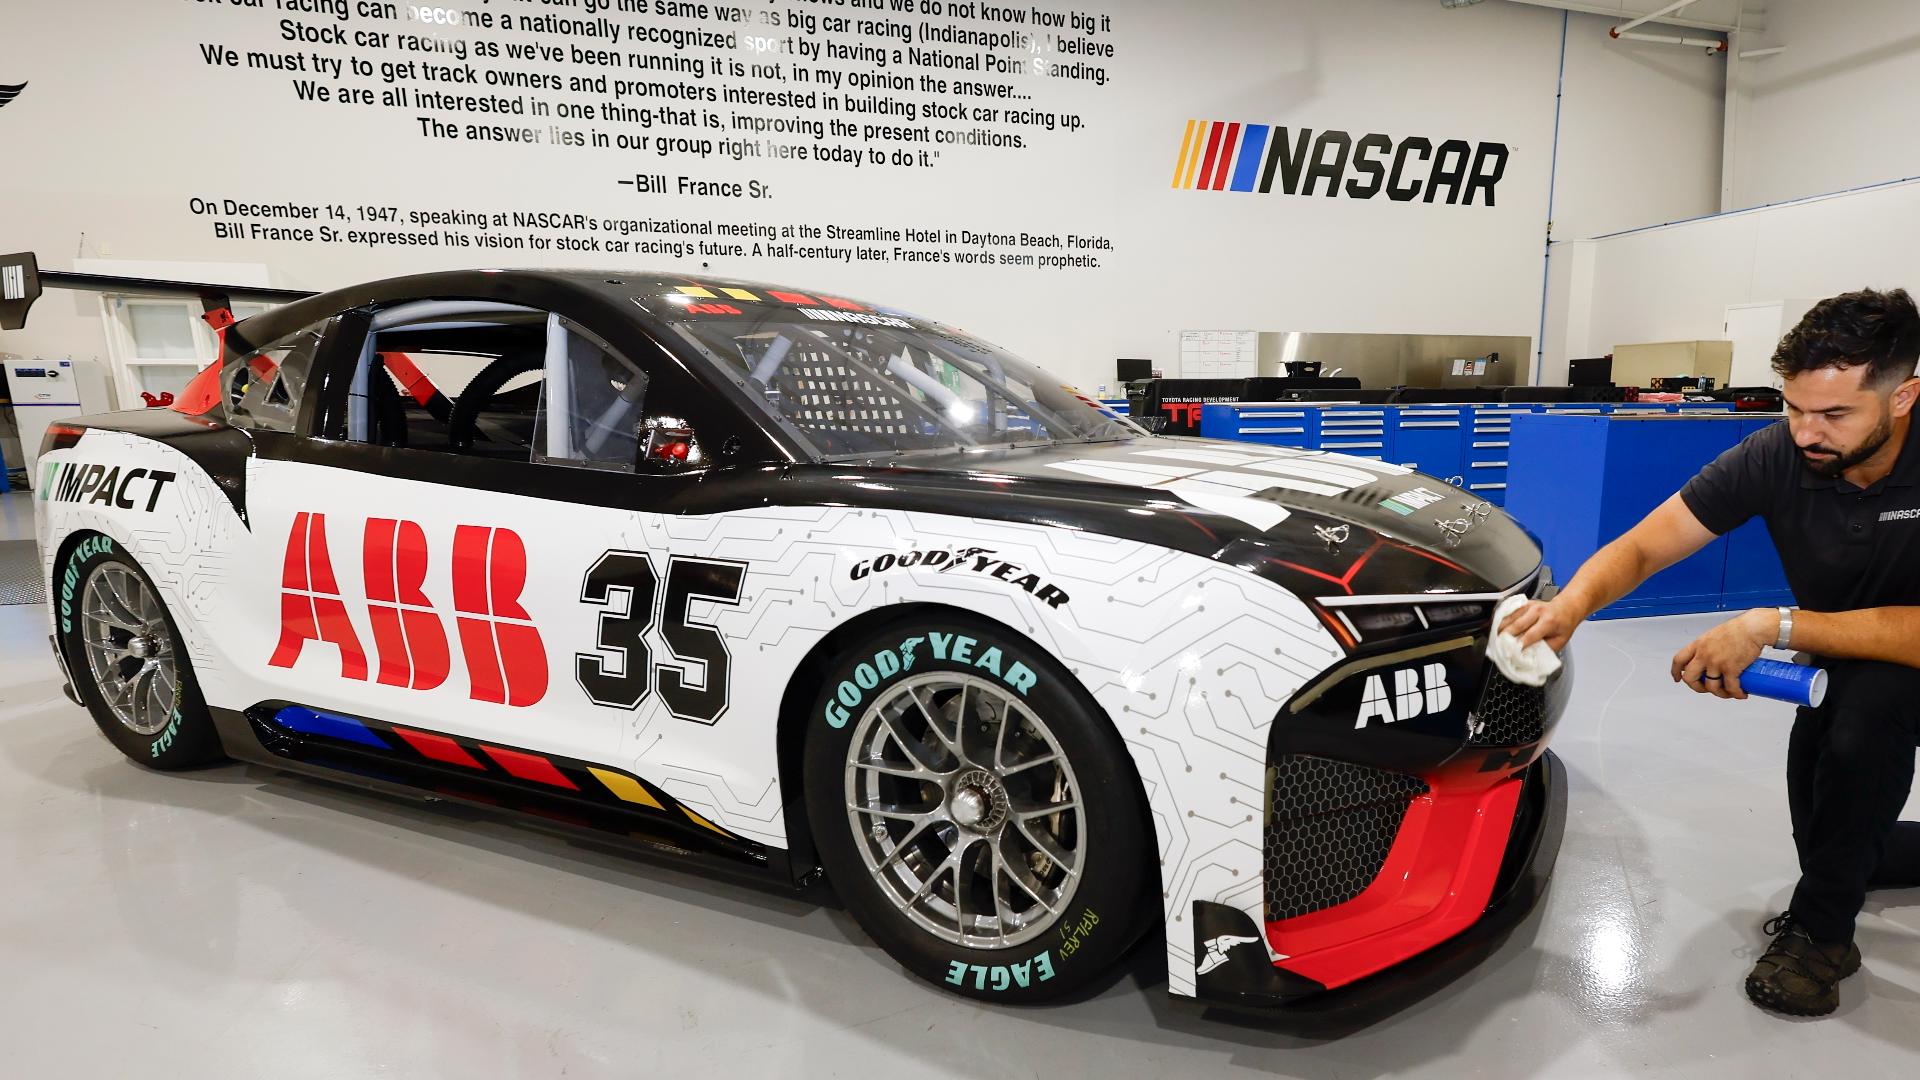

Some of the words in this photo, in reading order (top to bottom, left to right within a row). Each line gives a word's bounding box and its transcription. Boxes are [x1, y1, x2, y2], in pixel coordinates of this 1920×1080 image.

[275, 0, 350, 22] racing
[356, 0, 398, 21] can
[406, 4, 494, 29] become
[499, 13, 513, 31] a
[519, 13, 621, 45] nationally
[627, 25, 737, 50] recognized
[743, 34, 795, 55] sport
[798, 35, 821, 62] by
[826, 38, 887, 68] having
[892, 49, 903, 65] a
[908, 46, 980, 71] National
[583, 0, 611, 15] go
[616, 0, 649, 15] the
[654, 0, 709, 20] same
[713, 5, 753, 28] way
[759, 10, 781, 27] as
[786, 8, 817, 36] big
[822, 16, 852, 33] car
[856, 17, 913, 44] racing
[1056, 34, 1115, 58] believe
[889, 0, 915, 14] we
[919, 0, 943, 16] do
[947, 1, 976, 20] not
[980, 1, 1027, 24] know
[1031, 6, 1066, 28] how
[1070, 10, 1096, 36] big
[1100, 13, 1111, 33] it
[279, 18, 349, 46] Stock
[354, 30, 390, 49] car
[397, 34, 468, 61] racing
[474, 40, 500, 58] as
[504, 41, 565, 63] we've
[570, 43, 622, 67] been
[627, 52, 705, 80] running
[710, 55, 724, 76] it
[728, 57, 746, 78] is
[751, 62, 787, 84] not,
[792, 62, 809, 83] in
[815, 69, 843, 90] my
[847, 69, 915, 92] opinion
[919, 74, 948, 94] the
[198, 43, 240, 67] We
[246, 51, 307, 72] must
[310, 52, 343, 80] try
[349, 55, 374, 77] to
[380, 60, 417, 84] get
[421, 61, 479, 85] track
[484, 69, 563, 91] owners
[569, 74, 608, 94] and
[613, 79, 718, 102] promoters
[722, 83, 817, 110] interested
[822, 91, 839, 111] in
[844, 93, 916, 122] building
[921, 101, 969, 121] stock
[972, 107, 999, 123] car
[1004, 107, 1055, 131] racing
[1060, 114, 1085, 133] up.
[292, 79, 331, 103] We
[337, 87, 375, 106] are
[381, 86, 408, 108] all
[414, 88, 524, 115] interested
[530, 96, 550, 117] in
[556, 102, 595, 120] one
[600, 101, 698, 129] thing-that
[702, 108, 726, 133] is,
[731, 110, 824, 141] improving
[829, 118, 858, 138] the
[863, 124, 930, 143] present
[934, 127, 1027, 149] conditions.
[416, 116, 459, 140] The
[465, 124, 542, 144] answer
[549, 126, 586, 147] lies
[591, 128, 610, 148] in
[616, 134, 650, 151] our
[655, 136, 713, 159] group
[718, 136, 762, 161] right
[766, 139, 808, 161] here
[812, 143, 864, 168] today
[867, 147, 886, 165] to
[891, 148, 914, 167] do
[1259, 126, 1510, 207] NASCAR
[677, 176, 743, 198] France
[748, 179, 773, 199] Sr.
[189, 197, 218, 216] On
[222, 199, 320, 220] December
[324, 204, 351, 224] 14,
[356, 205, 405, 226] 1947,
[409, 208, 488, 230] speaking
[492, 211, 509, 227] at
[512, 211, 598, 231] NASCAR's
[602, 217, 713, 236] organizational
[717, 221, 777, 242] meeting
[781, 224, 796, 238] at
[798, 223, 822, 239] the
[826, 224, 901, 242] Streamline
[905, 227, 941, 244] Hotel
[945, 229, 958, 244] in
[961, 230, 1016, 249] Daytona
[1020, 232, 1063, 251] Beach,
[1067, 234, 1114, 252] Florida,
[213, 221, 245, 240] Bill
[249, 223, 315, 242] France
[319, 225, 343, 243] Sr.
[347, 230, 439, 249] expressed
[443, 230, 470, 248] his
[473, 232, 524, 249] vision
[528, 233, 552, 250] for
[556, 235, 601, 252] stock
[604, 240, 630, 253] car
[634, 238, 695, 259] racing's
[698, 240, 747, 257] future.
[751, 242, 763, 257] A
[766, 242, 852, 264] half-century
[856, 245, 889, 261] later,
[893, 246, 951, 263] France's
[953, 250, 996, 265] words
[999, 253, 1034, 266] seem
[1038, 253, 1101, 271] prophetic.
[55, 462, 177, 513] IMPACT
[268, 512, 549, 707] ABB
[575, 548, 749, 726] 35
[1354, 662, 1452, 730] ABB
[151, 705, 183, 759] EAGLE
[944, 949, 1056, 991] EAGLE
